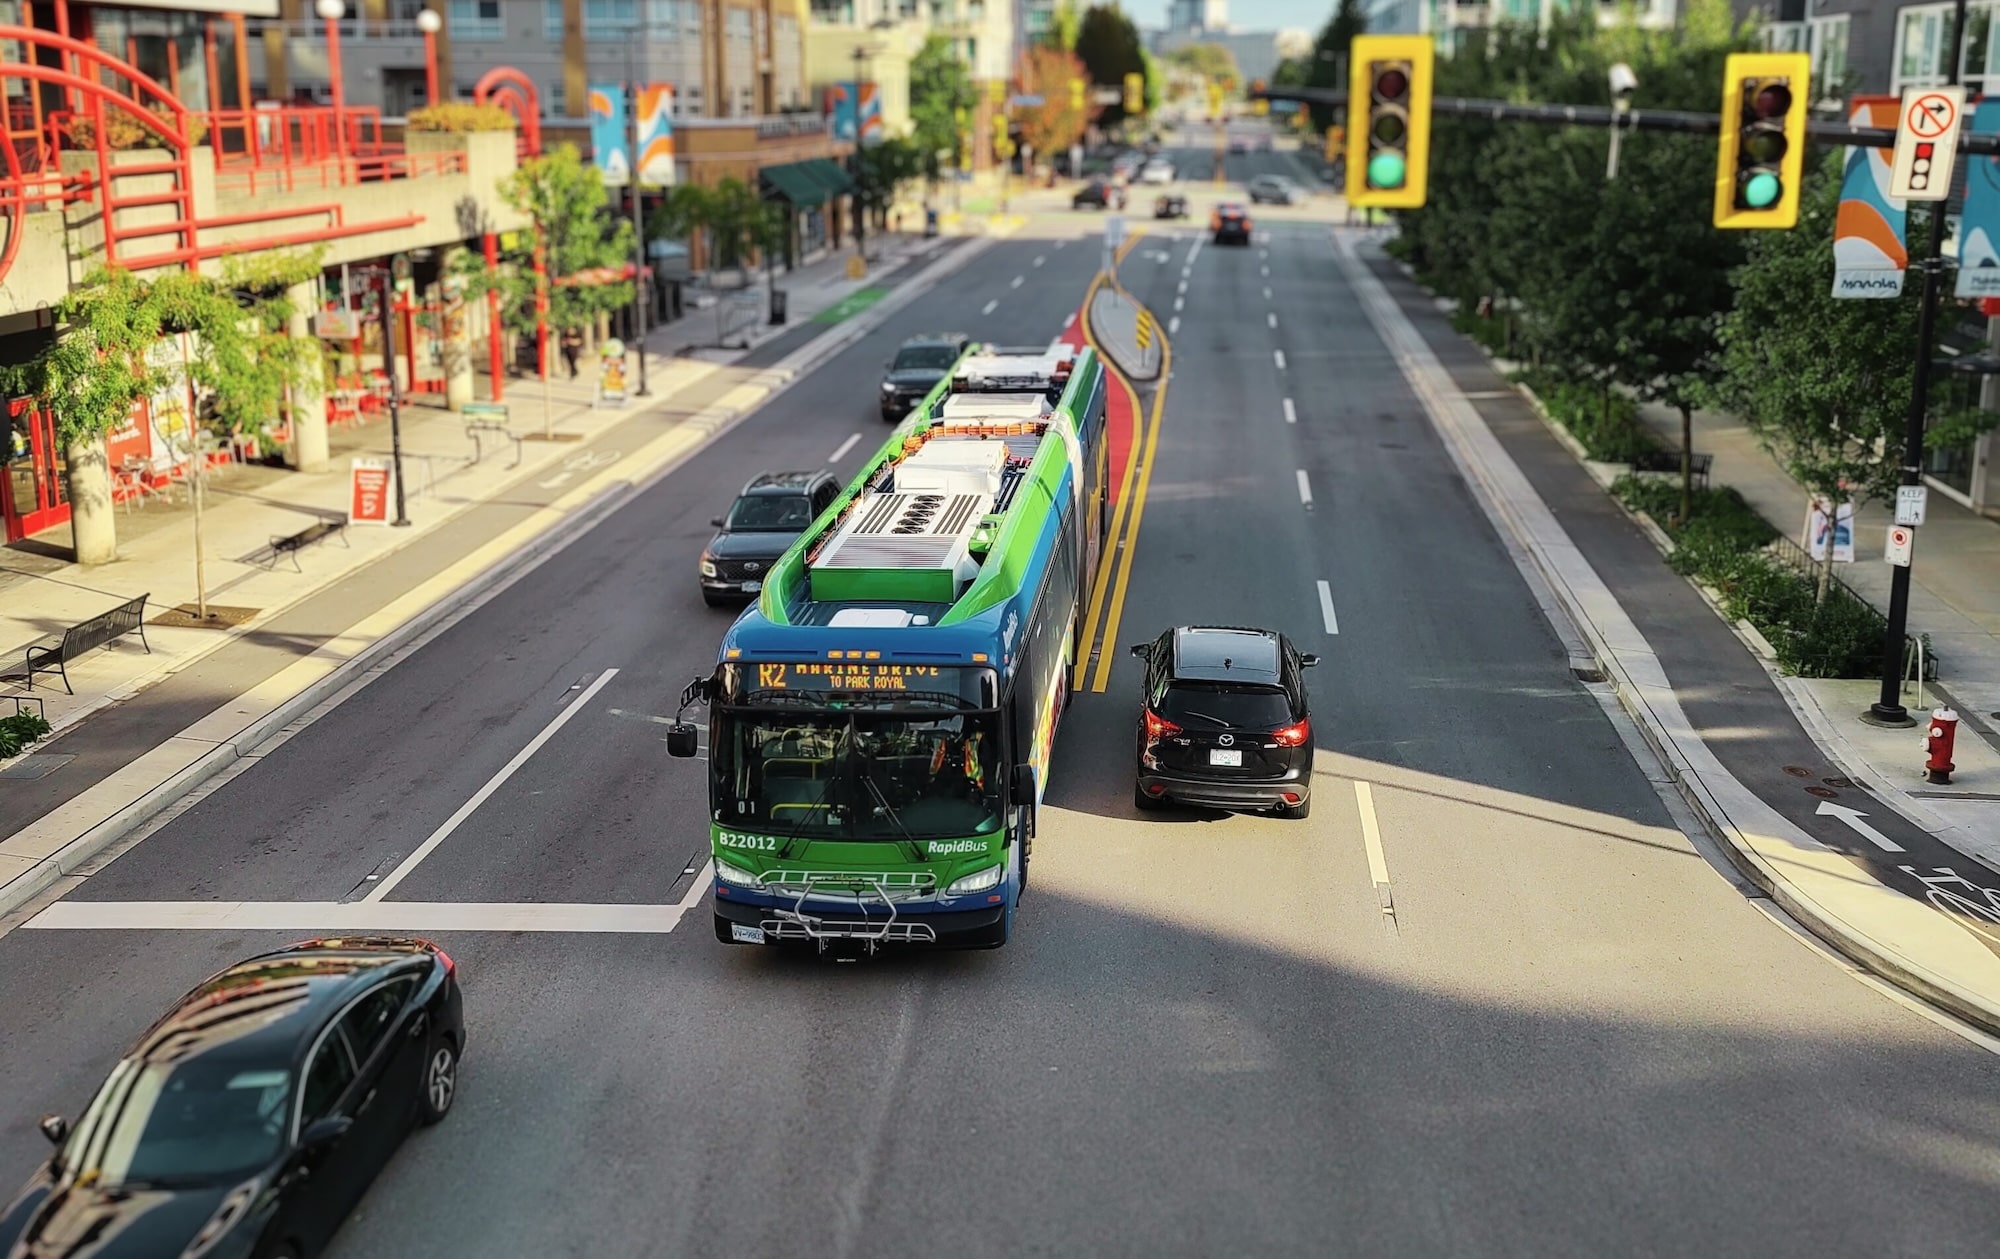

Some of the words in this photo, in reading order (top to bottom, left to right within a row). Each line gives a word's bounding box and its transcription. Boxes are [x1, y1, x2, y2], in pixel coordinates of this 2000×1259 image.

[758, 664, 787, 687] R2
[830, 676, 841, 688] TO
[845, 676, 870, 688] PARK
[874, 677, 906, 689] ROYAL
[719, 832, 776, 851] B22012
[928, 841, 988, 856] RapidBus
